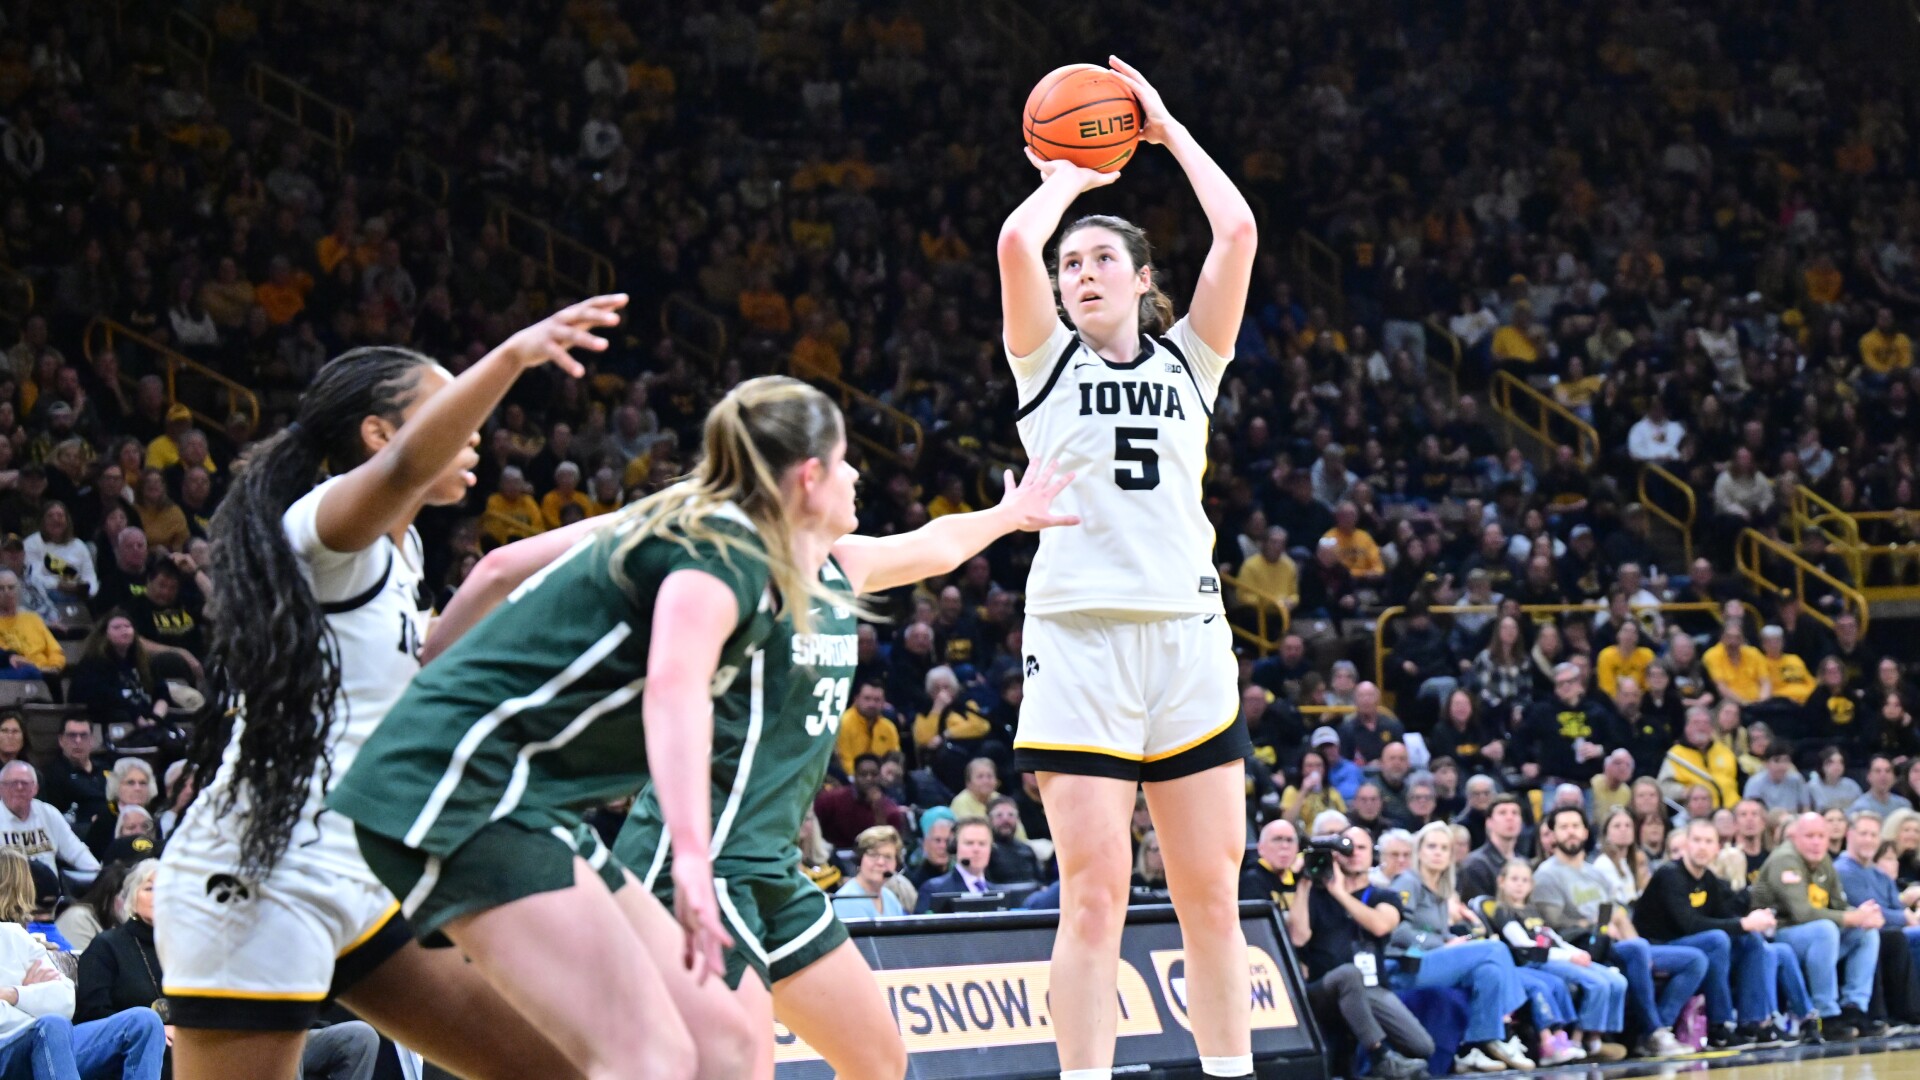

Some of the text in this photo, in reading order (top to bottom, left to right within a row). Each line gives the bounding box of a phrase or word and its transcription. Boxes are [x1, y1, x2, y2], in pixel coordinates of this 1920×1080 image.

[1079, 112, 1135, 138] ELITE
[1078, 381, 1186, 421] IOWA
[1114, 426, 1161, 491] 5
